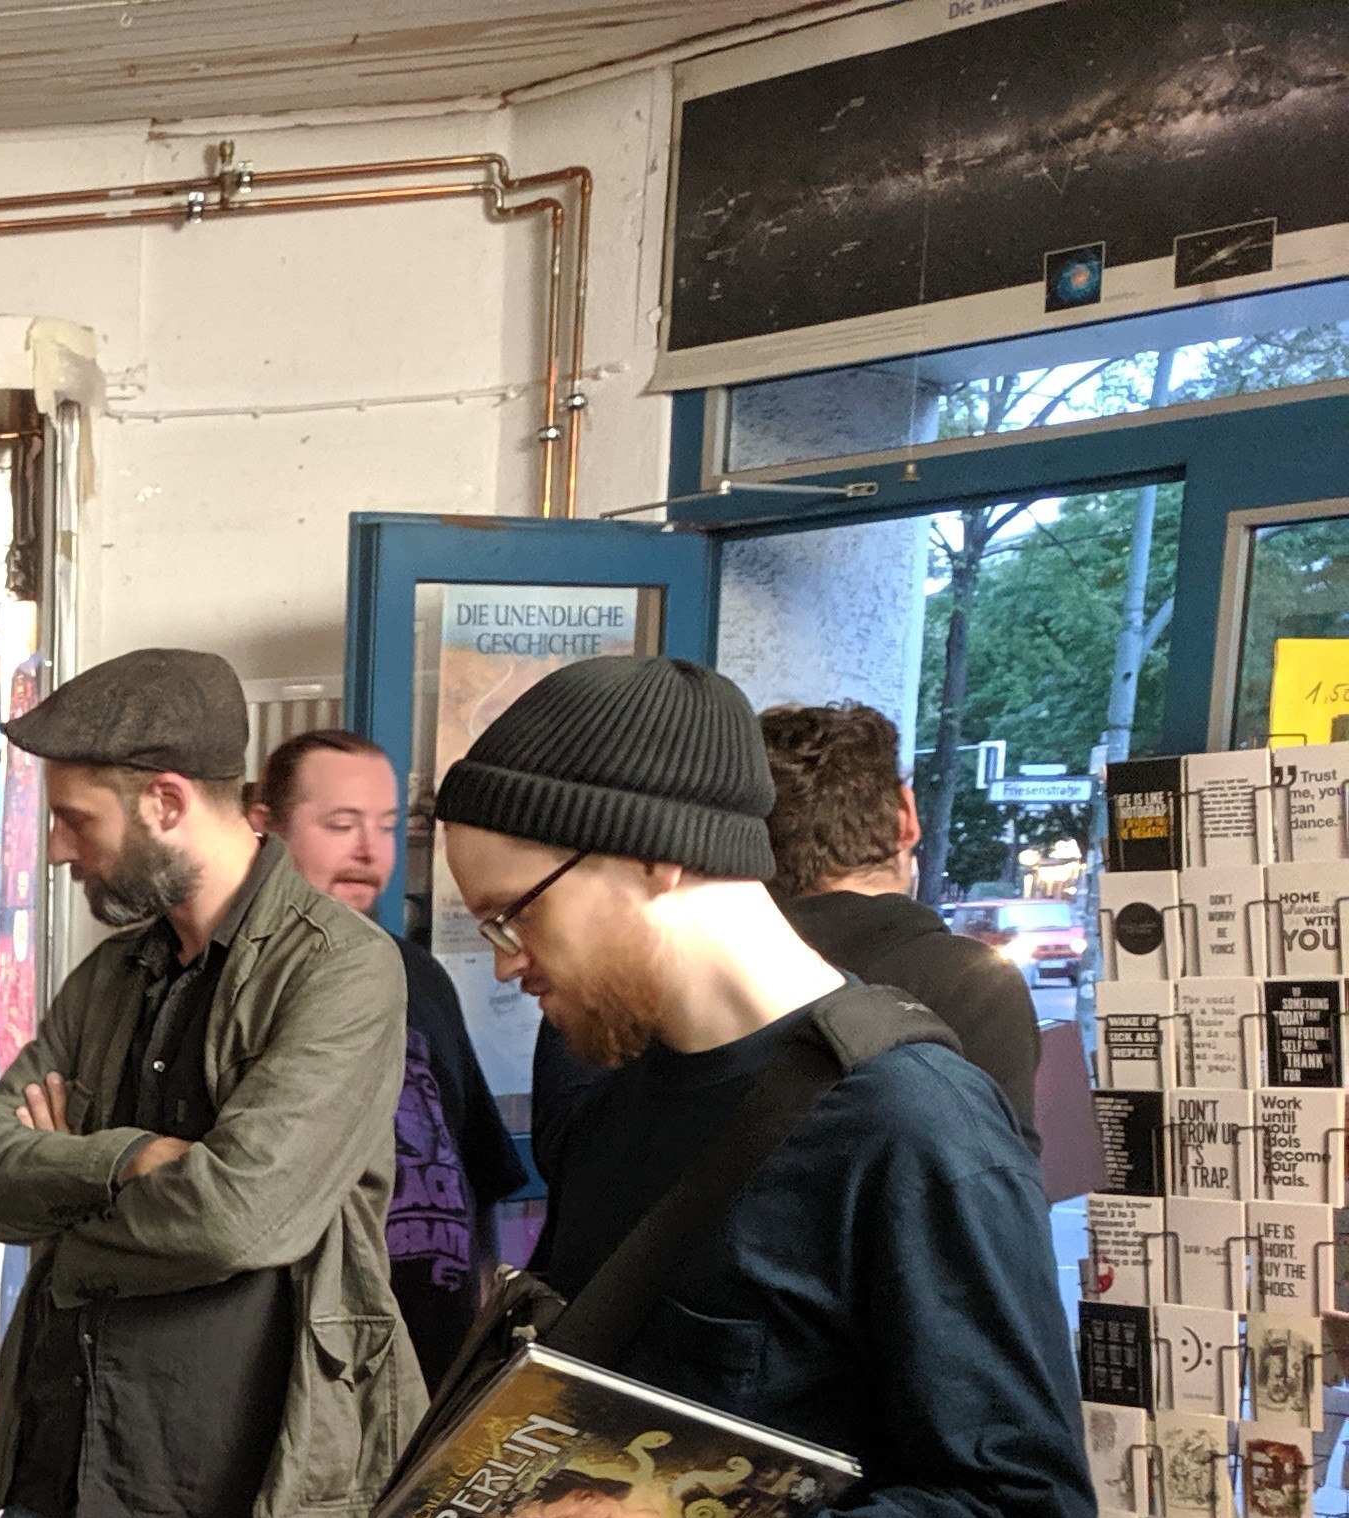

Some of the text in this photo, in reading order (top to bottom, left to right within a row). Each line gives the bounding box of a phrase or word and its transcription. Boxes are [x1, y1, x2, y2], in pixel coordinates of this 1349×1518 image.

[456, 604, 625, 630] DIE UNENDLICHE
[476, 633, 603, 655] GESCHICHTE
[1301, 769, 1337, 783] Trust
[1290, 803, 1315, 814] can
[1279, 892, 1320, 904] HOME
[1304, 916, 1338, 926] WITH
[1281, 929, 1339, 951] YOU
[1282, 998, 1330, 1010] SOMETHING
[1273, 1011, 1305, 1026] TODAY
[1286, 1053, 1324, 1070] THANK
[1179, 1100, 1219, 1121] DON'T
[1261, 1096, 1302, 1110] Work
[1262, 1112, 1296, 1123] until
[1191, 1166, 1230, 1189] TRAP.
[1257, 1222, 1295, 1239] LIFE IS
[1285, 1263, 1306, 1279] THE
